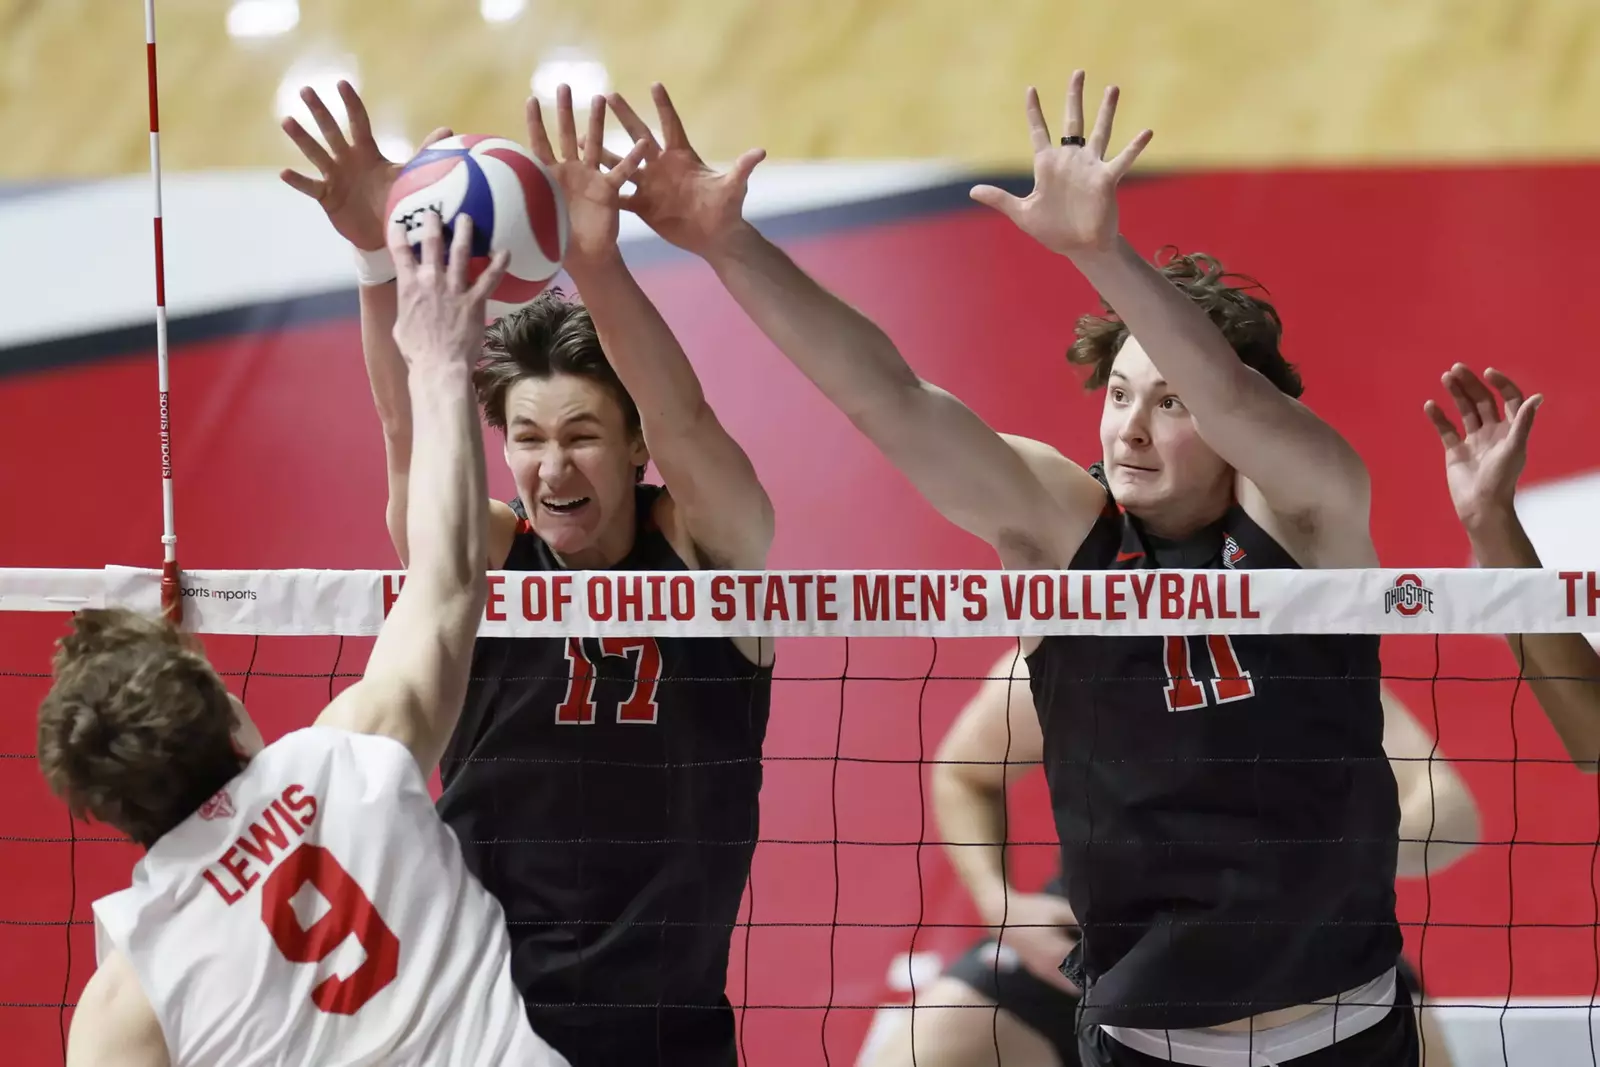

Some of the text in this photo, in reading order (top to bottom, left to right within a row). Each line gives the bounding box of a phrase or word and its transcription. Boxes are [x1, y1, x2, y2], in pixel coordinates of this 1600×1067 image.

[160, 393, 171, 477] sports imports
[180, 587, 257, 601] ports imports
[383, 574, 507, 622] HE
[521, 575, 573, 622] OF
[587, 575, 695, 622] OHIO
[710, 574, 838, 622] STATE
[1000, 573, 1261, 621] VOLLEYBALL
[554, 636, 663, 726] 17
[1162, 634, 1256, 713] 11
[202, 783, 318, 906] LEWIS
[260, 842, 401, 1016] 9
